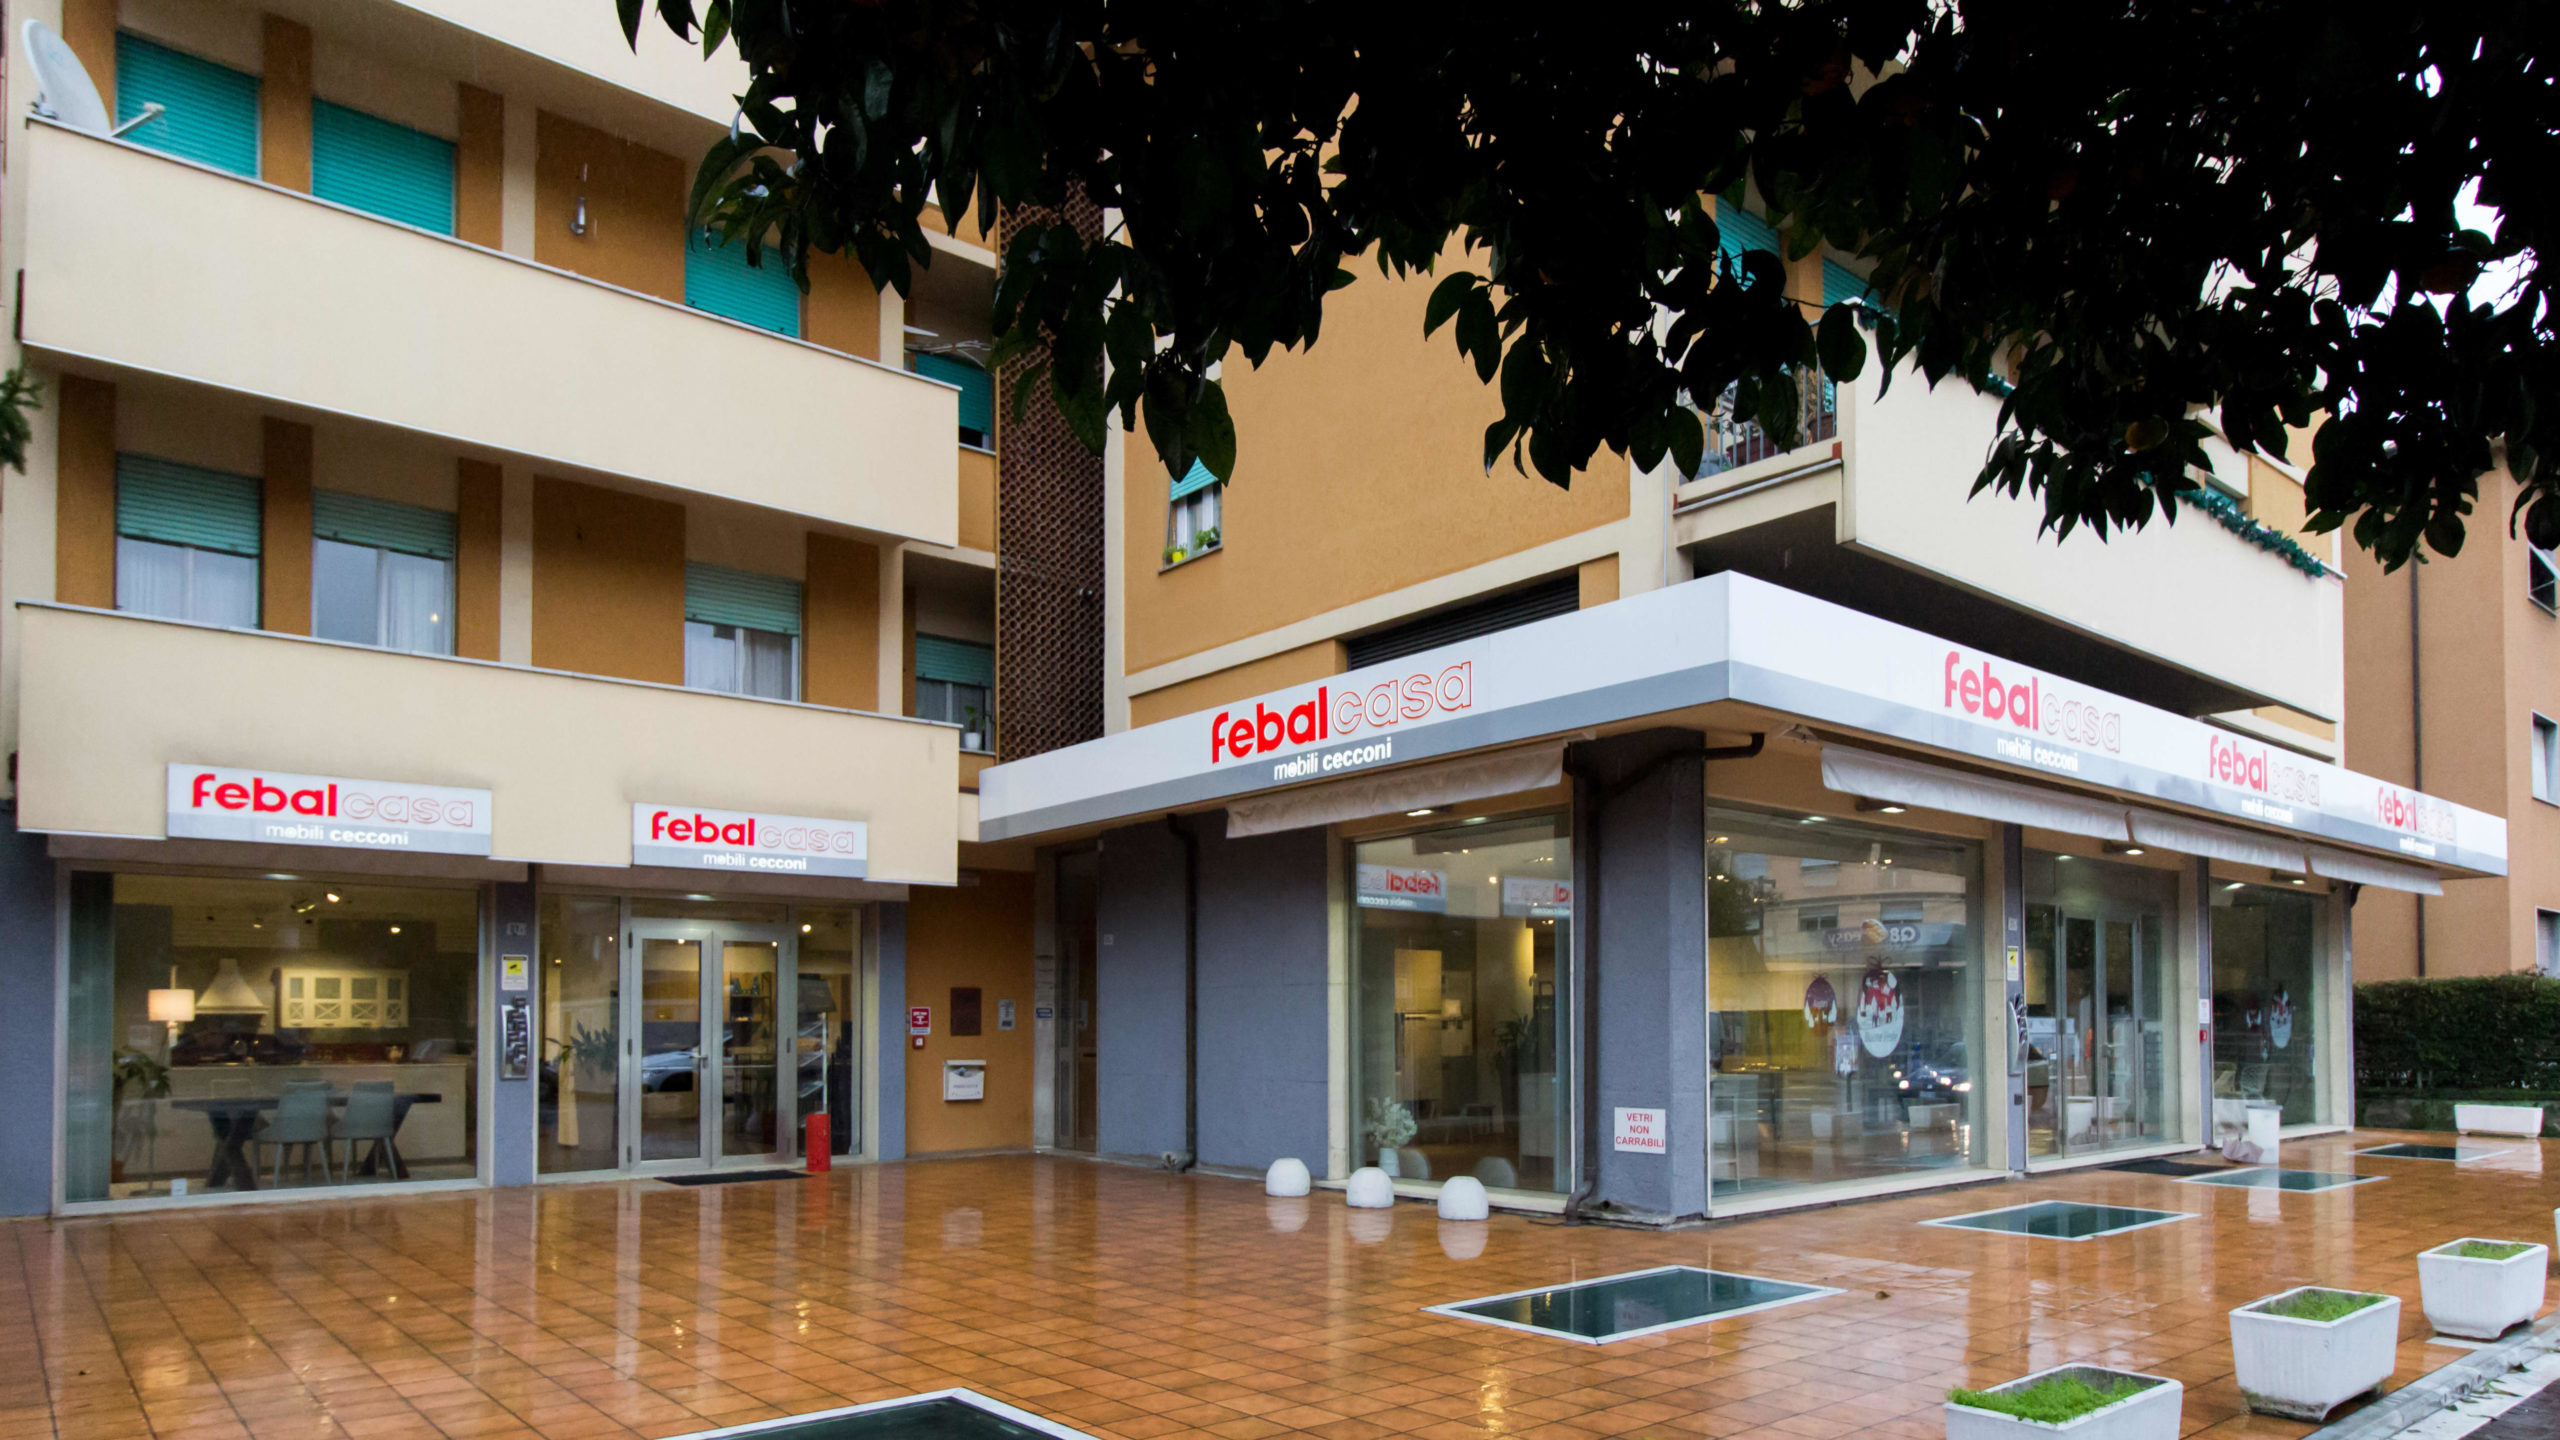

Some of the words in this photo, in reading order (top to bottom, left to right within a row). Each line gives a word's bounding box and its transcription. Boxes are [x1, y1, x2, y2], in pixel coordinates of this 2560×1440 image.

[1274, 751, 1319, 781] mobili
[1322, 736, 1392, 771] cecconi
[266, 824, 324, 841] mobili
[329, 828, 409, 845] cecconi
[703, 852, 746, 867] mobili
[749, 856, 807, 870] cecconi
[1626, 1112, 1653, 1123] VETRI
[1629, 1125, 1650, 1135] NON
[1615, 1136, 1665, 1148] CARRABILI
